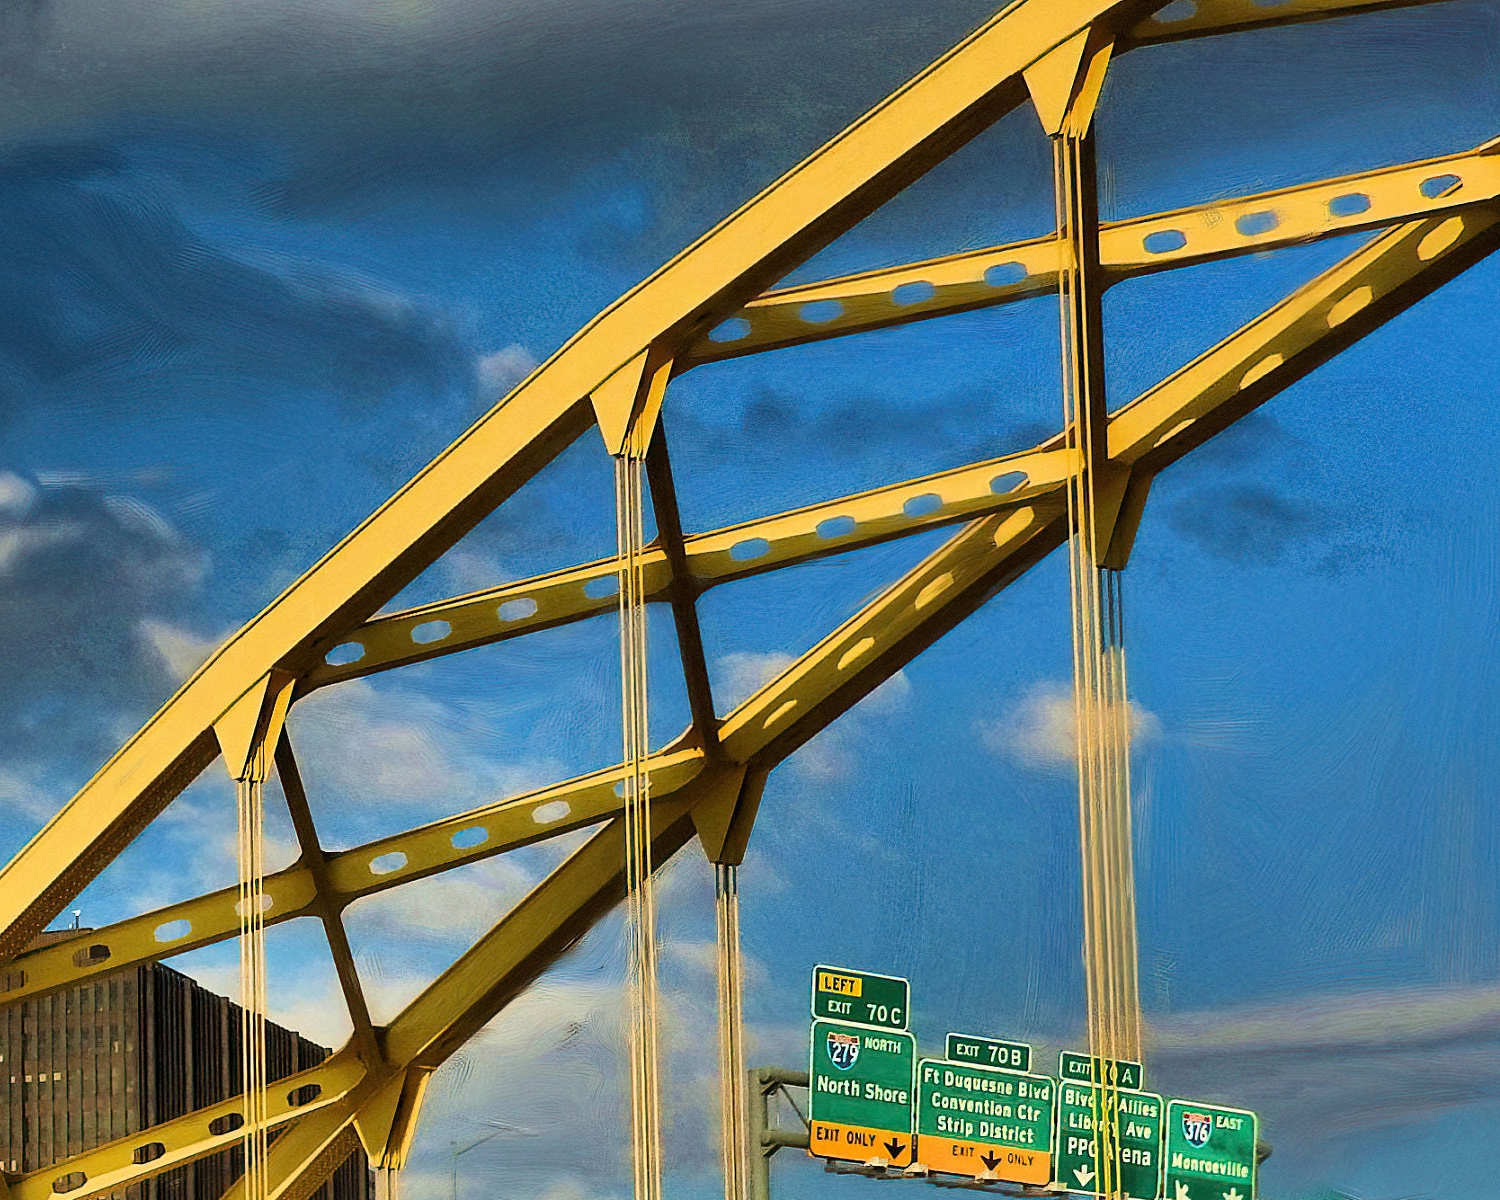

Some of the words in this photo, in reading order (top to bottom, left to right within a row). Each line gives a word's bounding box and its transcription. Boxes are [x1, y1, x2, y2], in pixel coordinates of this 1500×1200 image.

[825, 976, 855, 993] LEFT
[828, 1000, 852, 1015] EXIT
[831, 1042, 860, 1064] 279
[864, 1037, 901, 1054] NORTH
[956, 1043, 980, 1058] EXIT
[1069, 1060, 1092, 1075] EXIT
[818, 1075, 860, 1097] North
[865, 1083, 907, 1104] Shore
[924, 1067, 940, 1084] Ft
[944, 1071, 1013, 1095] Duquesne
[1018, 1081, 1050, 1101] Blvd
[932, 1092, 1012, 1118] Convention
[1017, 1104, 1042, 1122] Ctr
[1118, 1097, 1157, 1118] Allies
[937, 1115, 974, 1138] Strip
[979, 1121, 1035, 1144] District
[1125, 1121, 1152, 1139] Ave
[1185, 1121, 1208, 1142] 376
[1215, 1115, 1244, 1130] EAST
[816, 1127, 840, 1142] EXIT
[847, 1131, 876, 1147] ONLY
[952, 1145, 975, 1157] EXIT
[1007, 1153, 1034, 1166] ONLY
